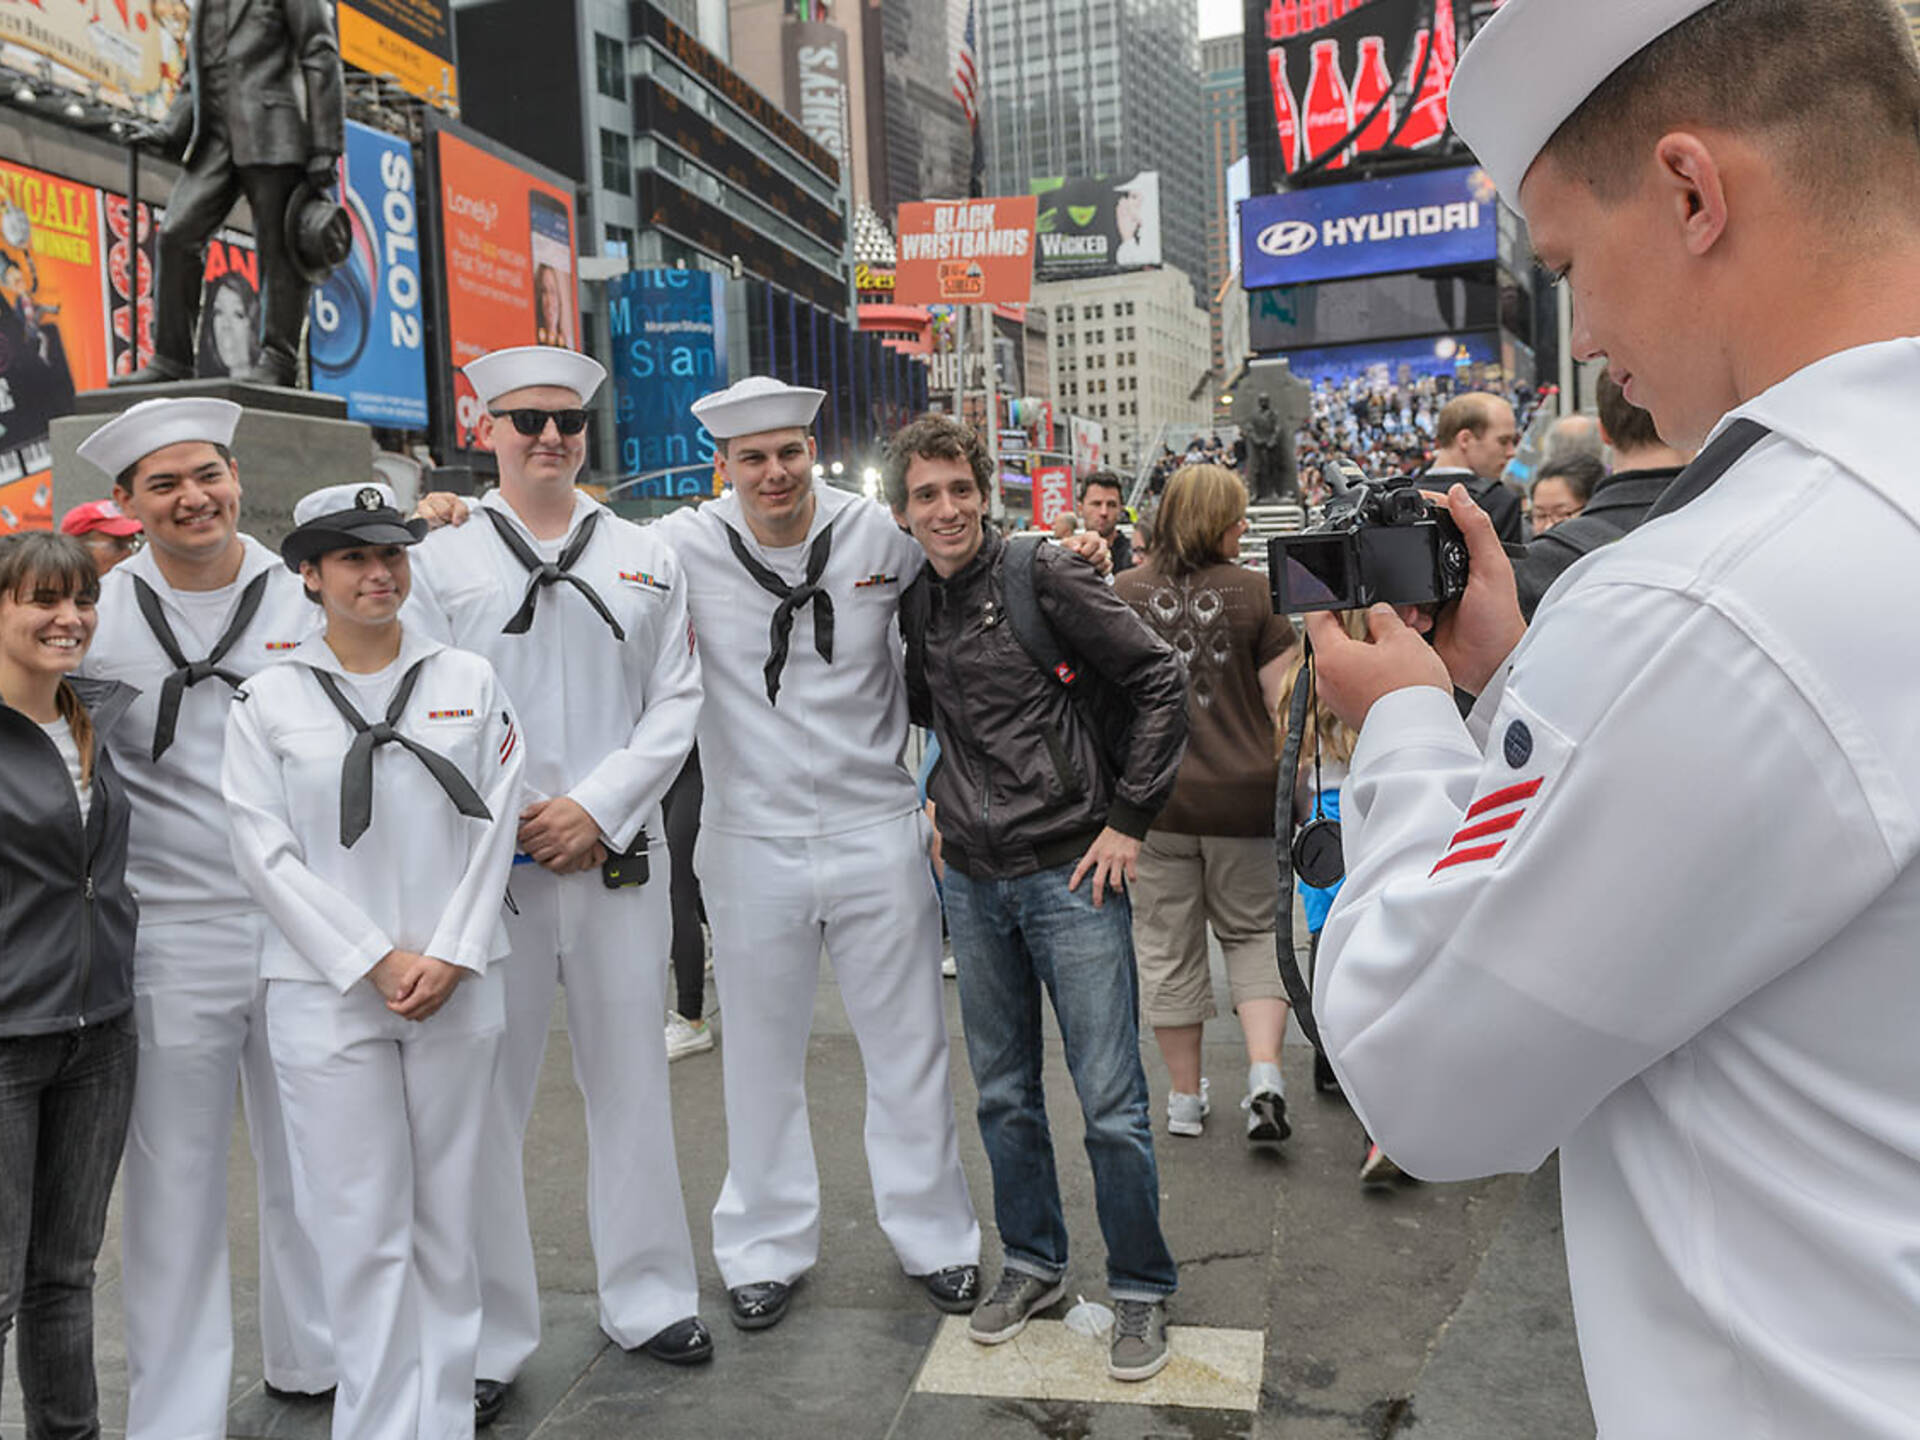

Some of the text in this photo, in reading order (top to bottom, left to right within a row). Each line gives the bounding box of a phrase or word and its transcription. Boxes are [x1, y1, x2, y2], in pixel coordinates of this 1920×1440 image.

[799, 44, 842, 160] SHEY'S
[934, 203, 995, 233] BLACK
[1322, 201, 1479, 247] HYUNDAI
[381, 150, 420, 349] SOLO 2
[901, 229, 1030, 260] WRISTBANDS
[1041, 471, 1067, 525] tkts
